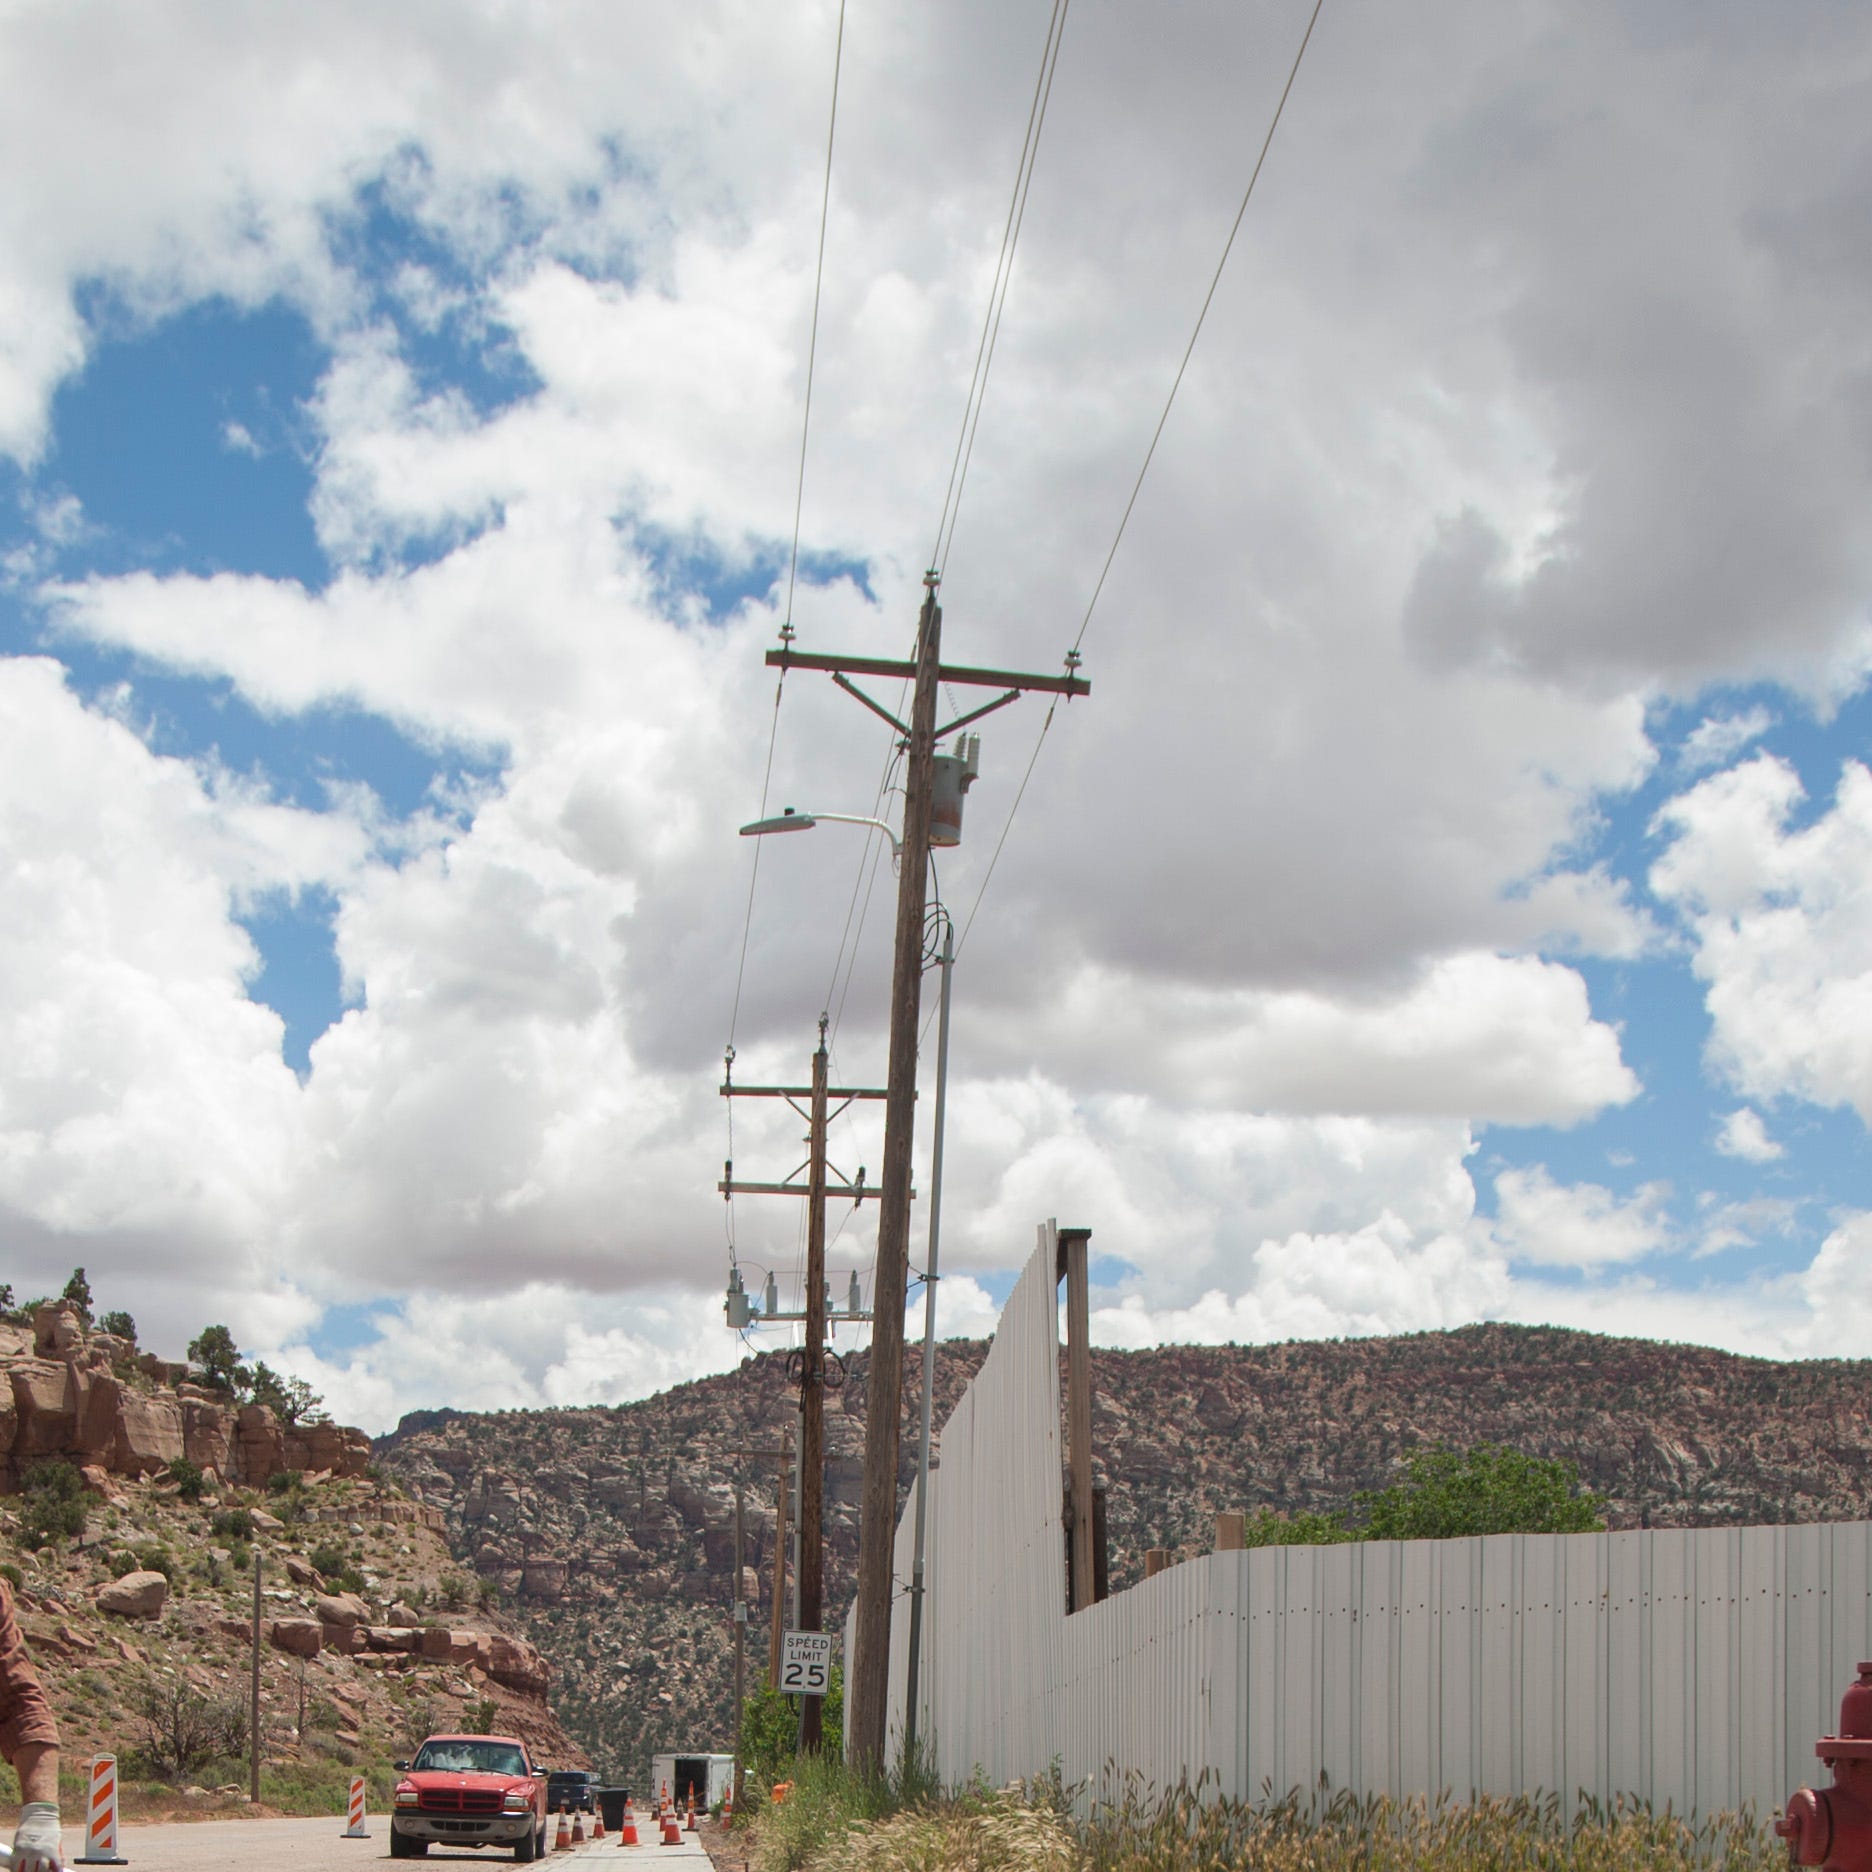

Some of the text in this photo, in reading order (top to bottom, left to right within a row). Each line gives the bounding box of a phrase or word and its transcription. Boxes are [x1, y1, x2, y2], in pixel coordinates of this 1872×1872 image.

[787, 1637, 829, 1650] SPEED
[790, 1650, 823, 1662] LIMIT
[785, 1663, 825, 1688] 25
